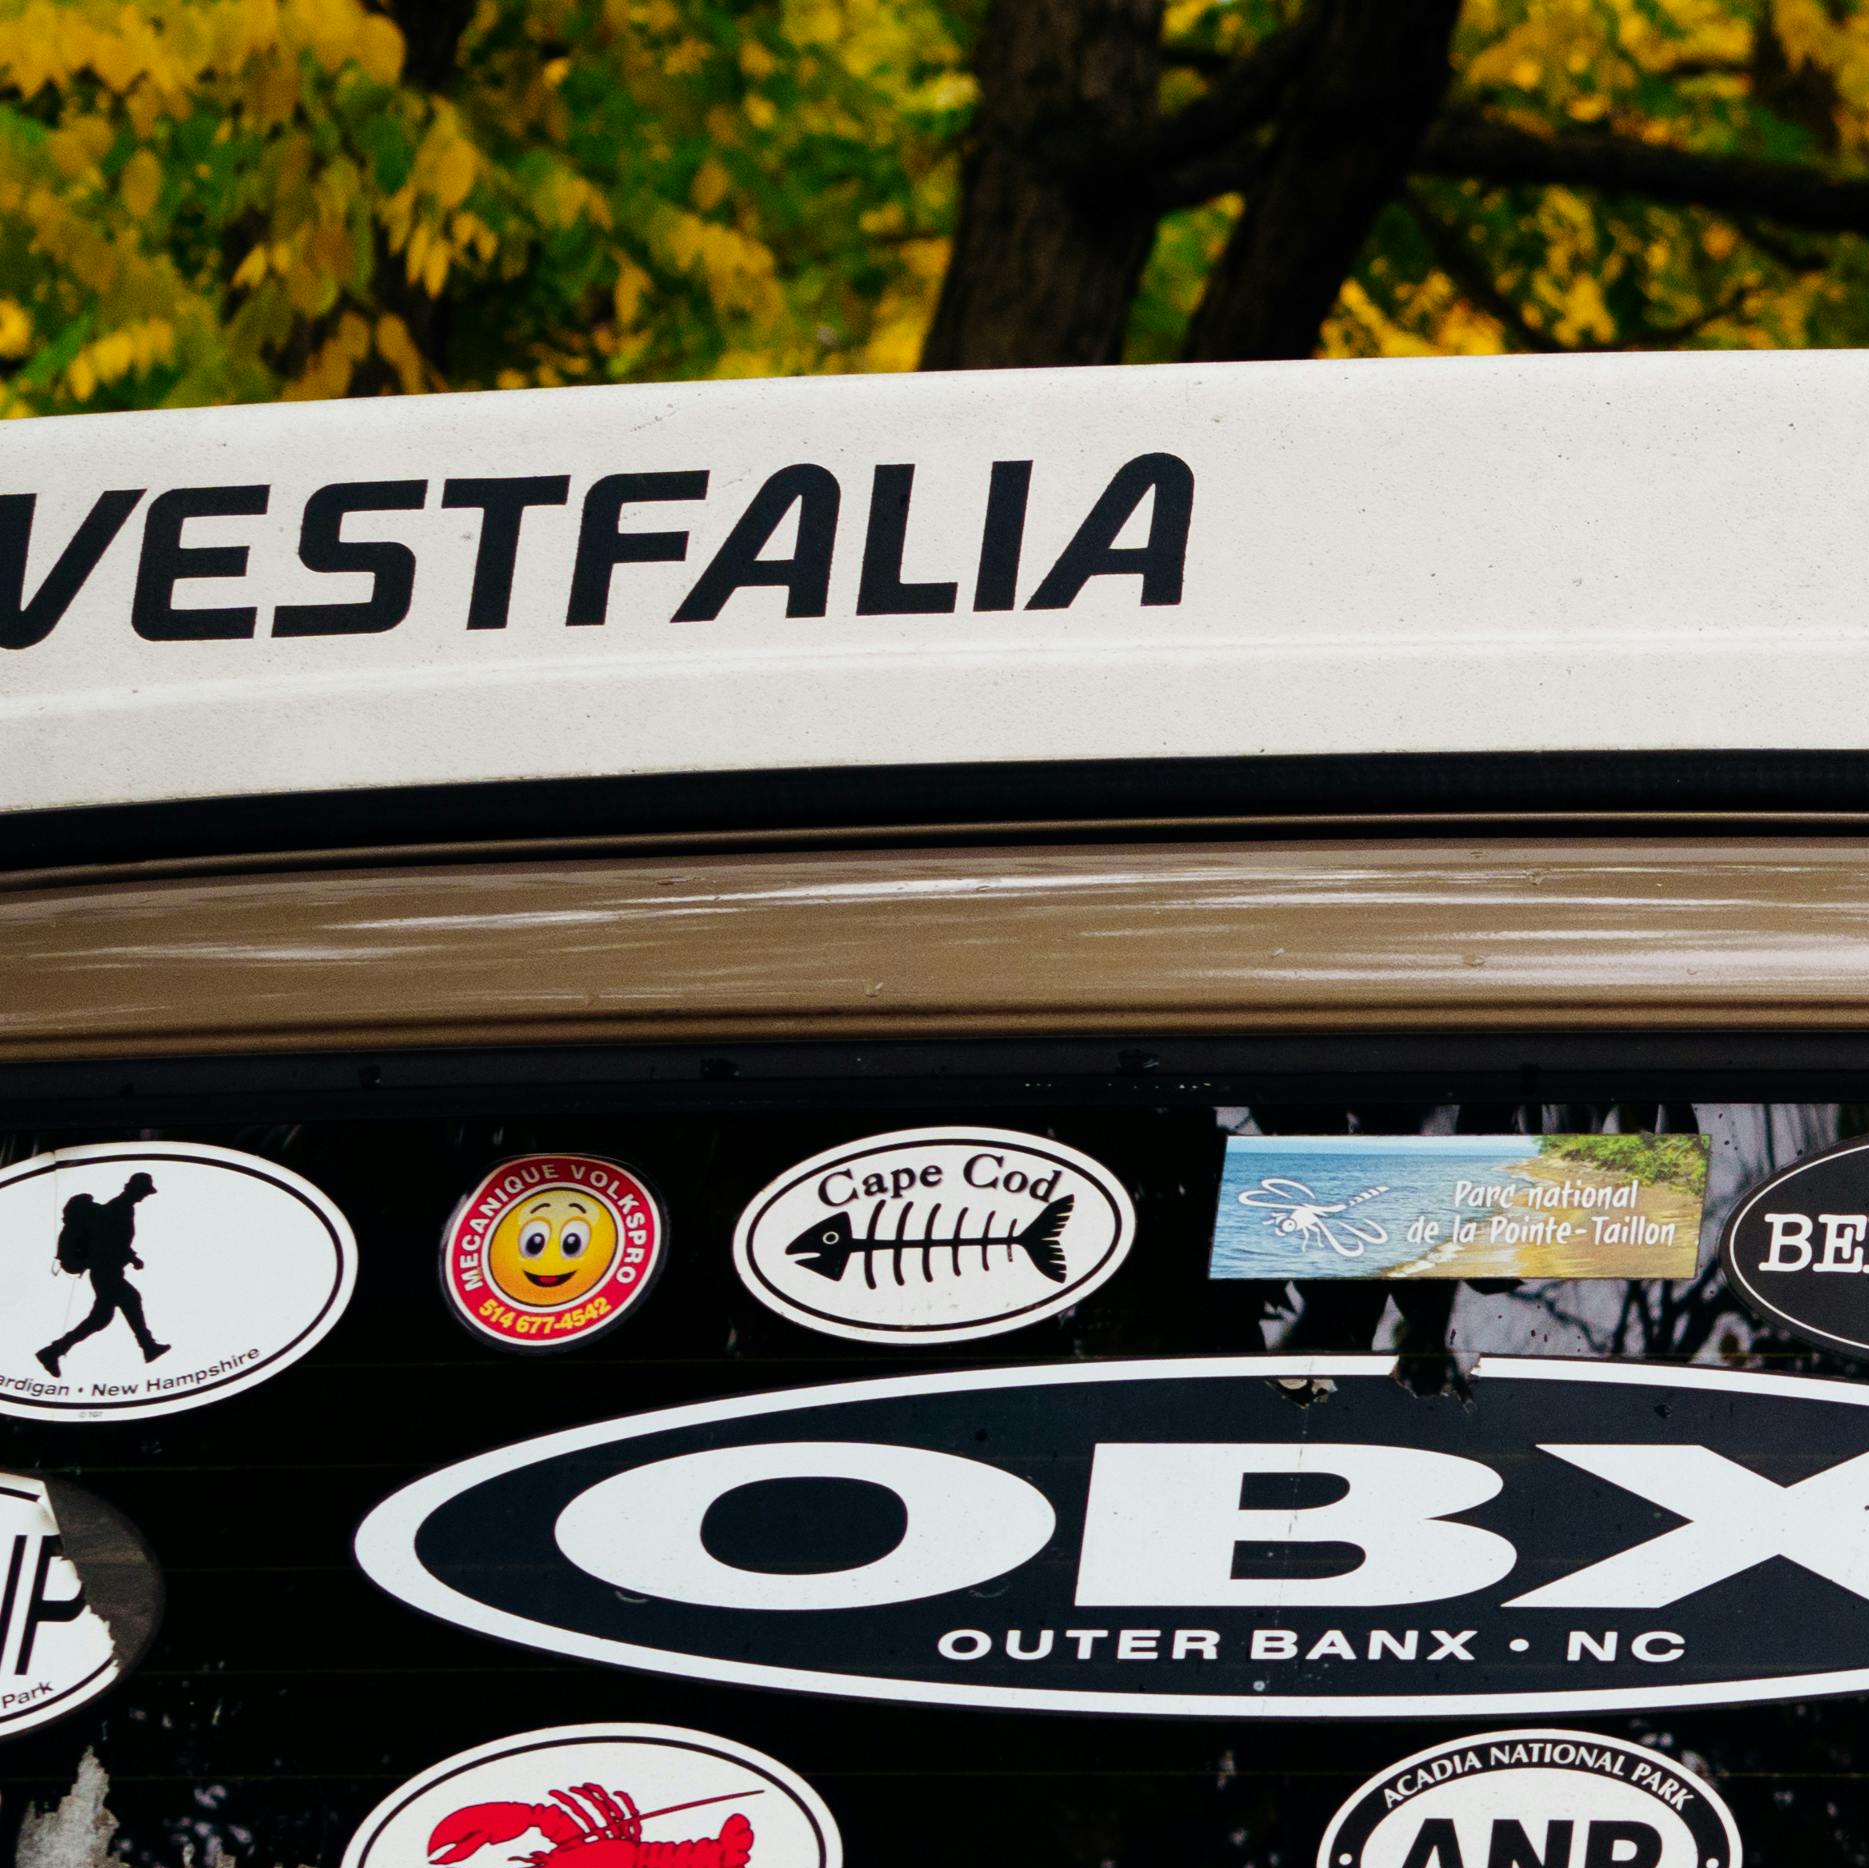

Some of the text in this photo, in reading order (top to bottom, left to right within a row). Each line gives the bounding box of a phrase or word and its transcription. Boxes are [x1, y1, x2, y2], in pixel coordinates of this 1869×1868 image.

[817, 1153, 1063, 1207] Cape Cod
[1454, 1179, 1639, 1210] Parc national
[459, 1164, 647, 1291] MECANIQUE VOLKSPRO
[1406, 1215, 1676, 1246] de la Pointe-Taillon
[478, 1297, 612, 1334] 514 677-4542
[0, 1347, 261, 1397] ardigan New Hampshire
[937, 1628, 1687, 1663] OUTER BANX NC
[1, 1679, 55, 1709] Park
[1382, 1743, 1696, 1811] ACADIA NATIONAL PARK
